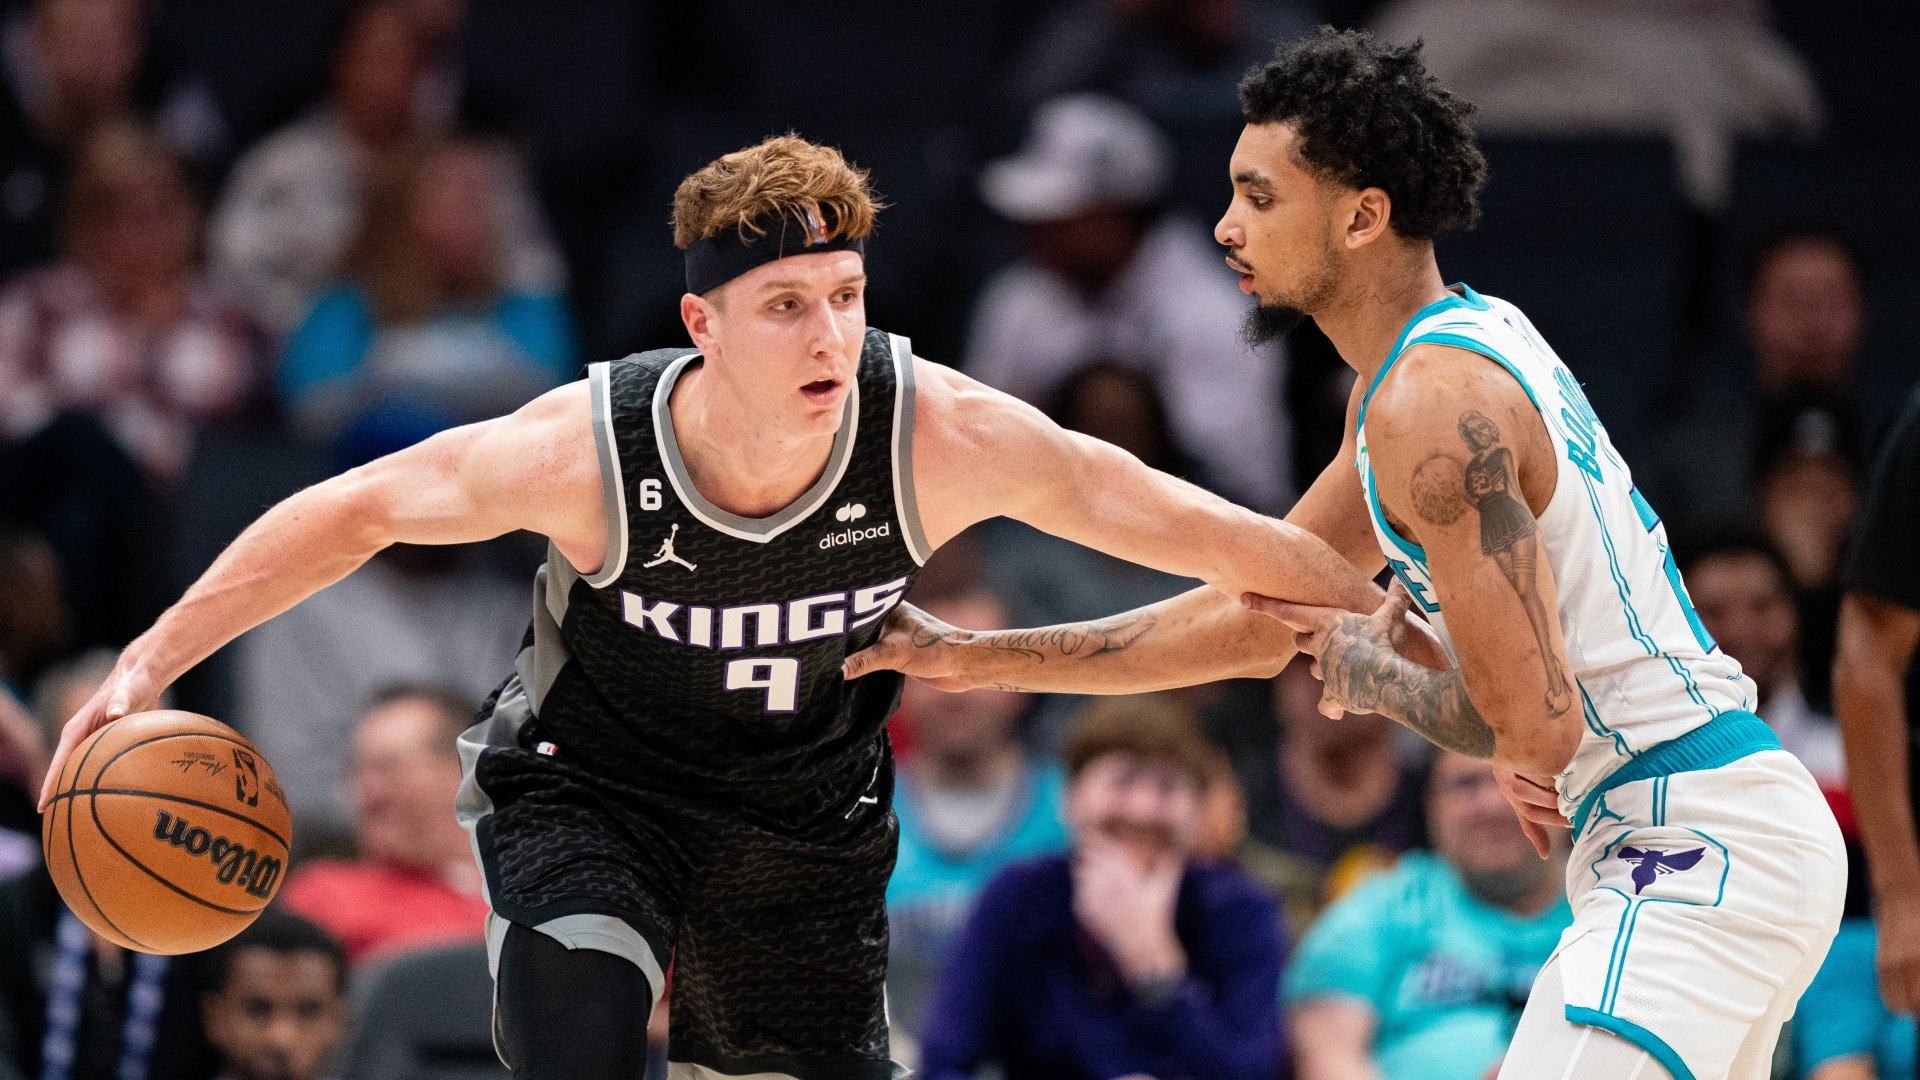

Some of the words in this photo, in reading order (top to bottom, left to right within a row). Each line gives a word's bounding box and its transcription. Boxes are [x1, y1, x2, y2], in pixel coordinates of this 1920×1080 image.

[639, 478, 663, 511] 6
[818, 522, 890, 549] dialpad
[620, 575, 911, 650] KINGS
[723, 656, 800, 714] 9
[153, 809, 281, 899] Wilson
